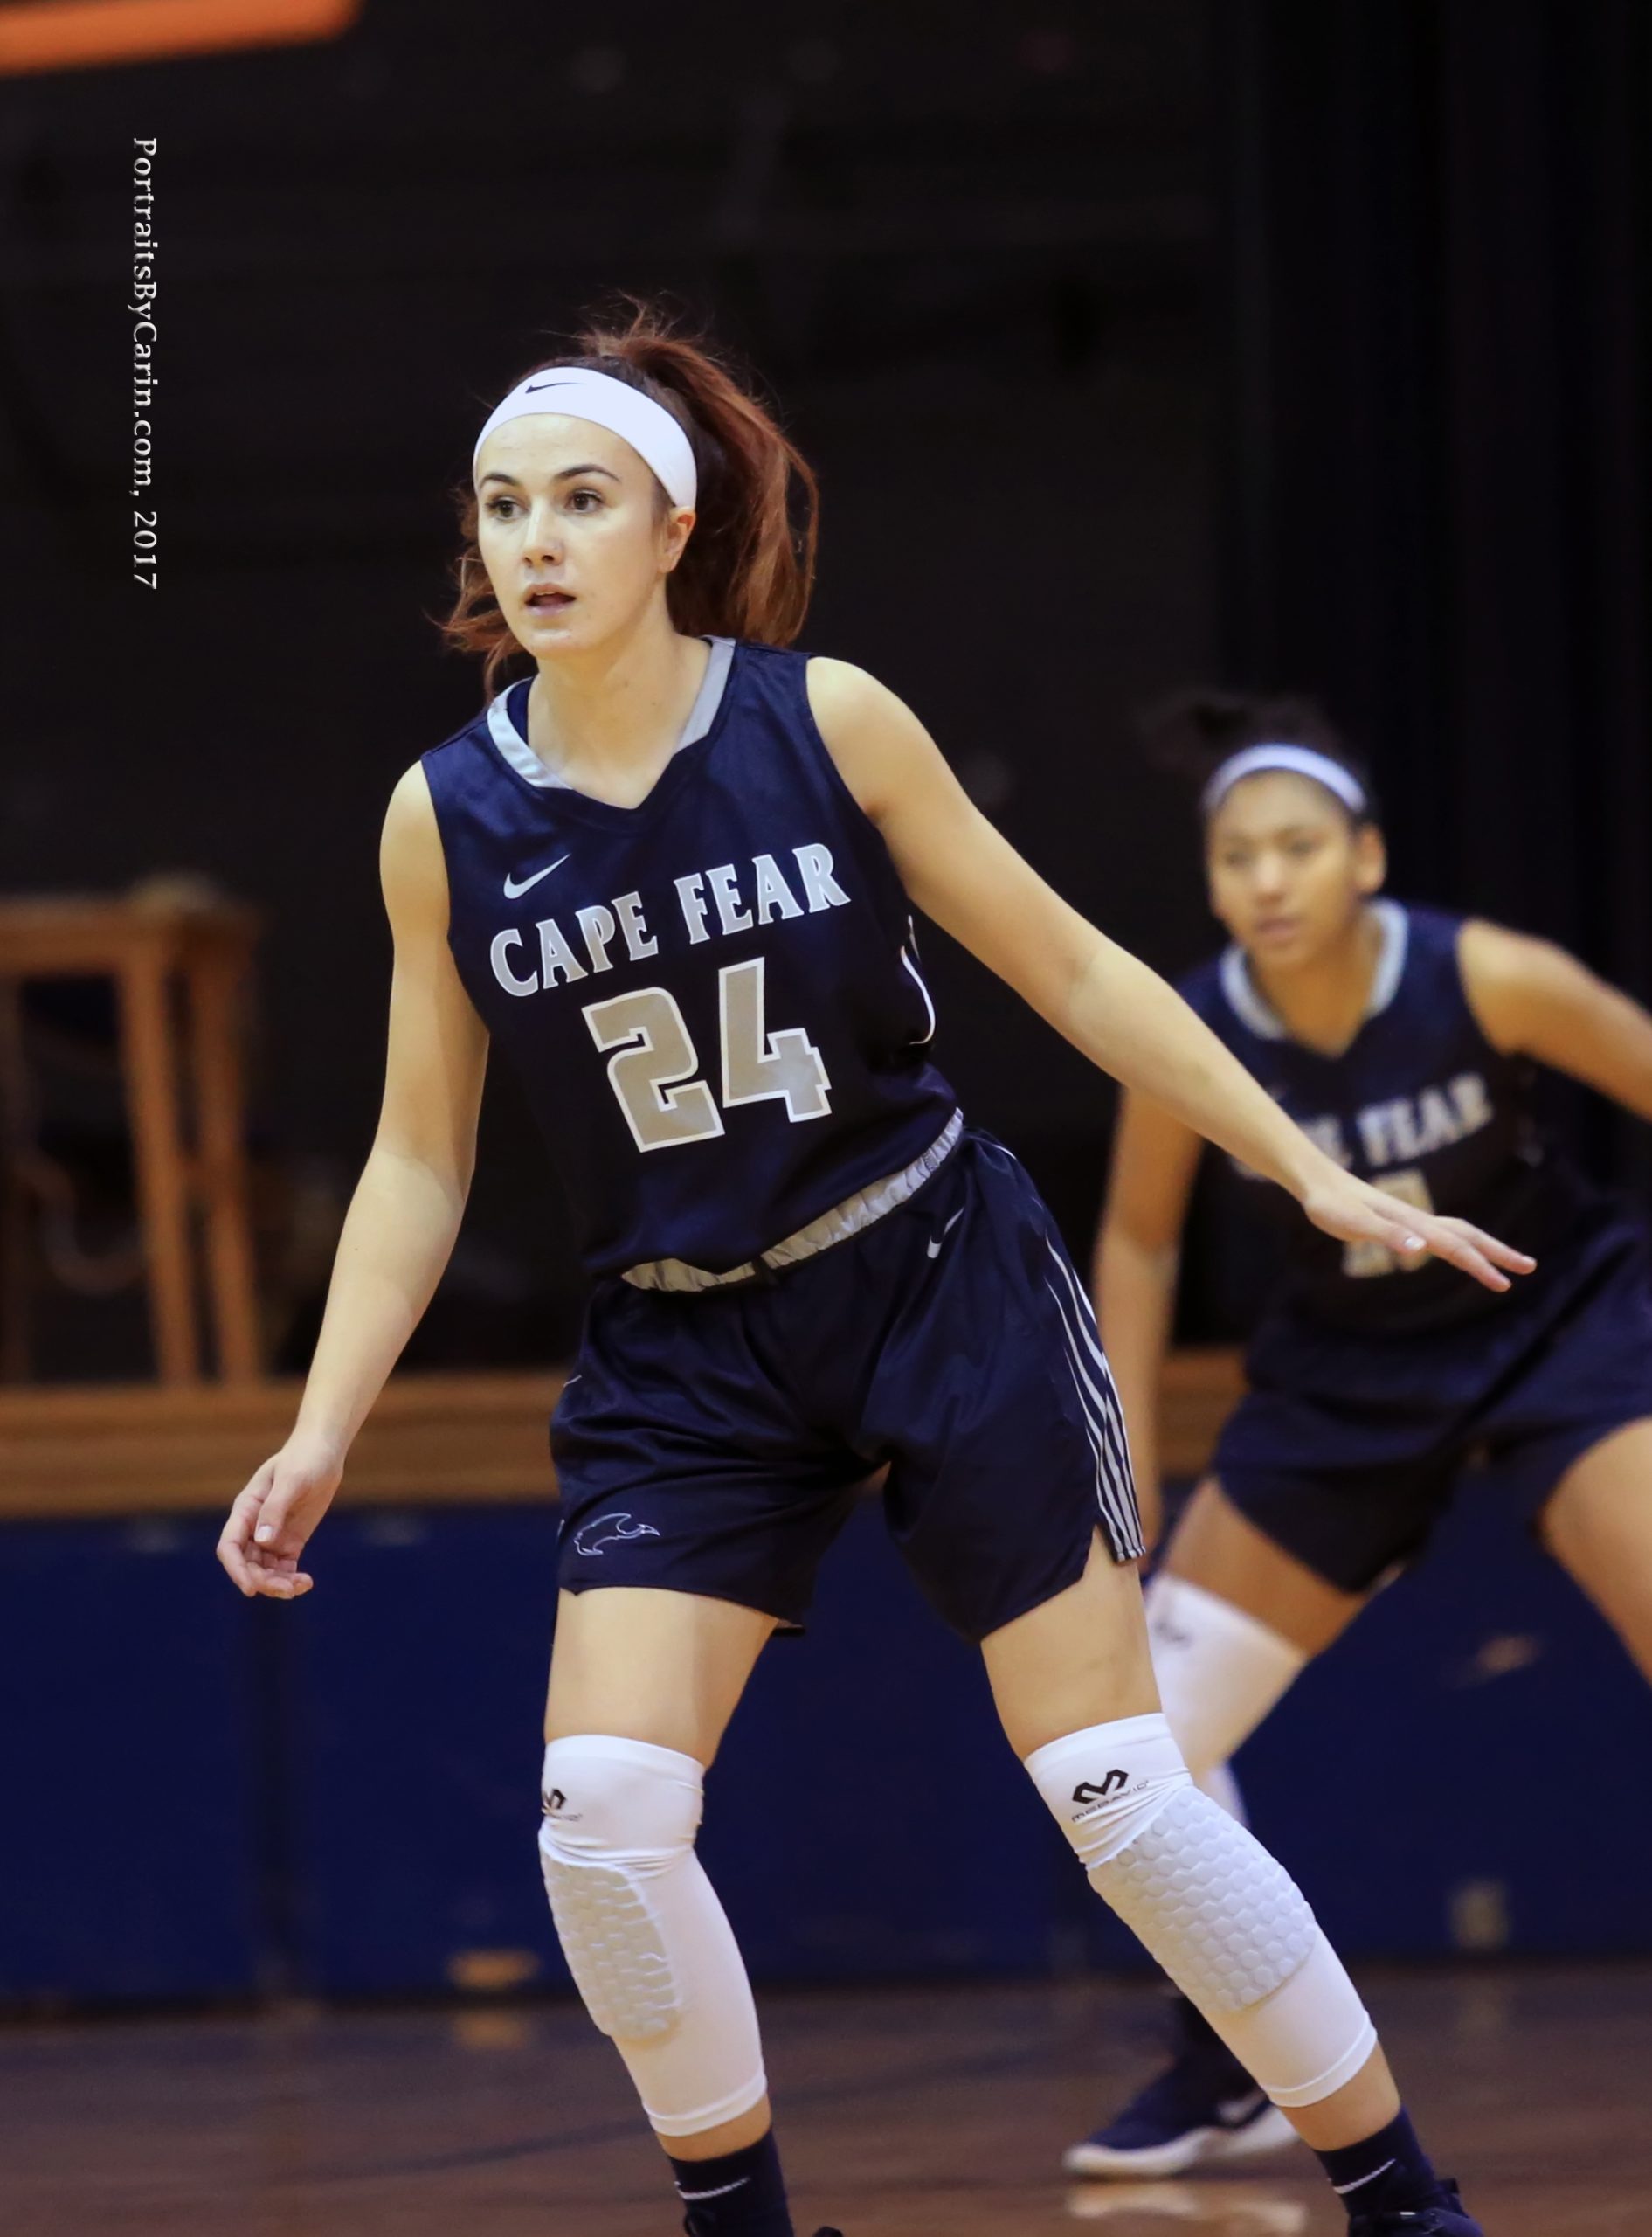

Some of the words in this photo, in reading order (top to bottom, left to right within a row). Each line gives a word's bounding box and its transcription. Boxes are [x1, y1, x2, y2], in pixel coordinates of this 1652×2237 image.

[489, 890, 659, 997] CAPE
[673, 842, 851, 945] FEAR
[581, 956, 832, 1153] 24
